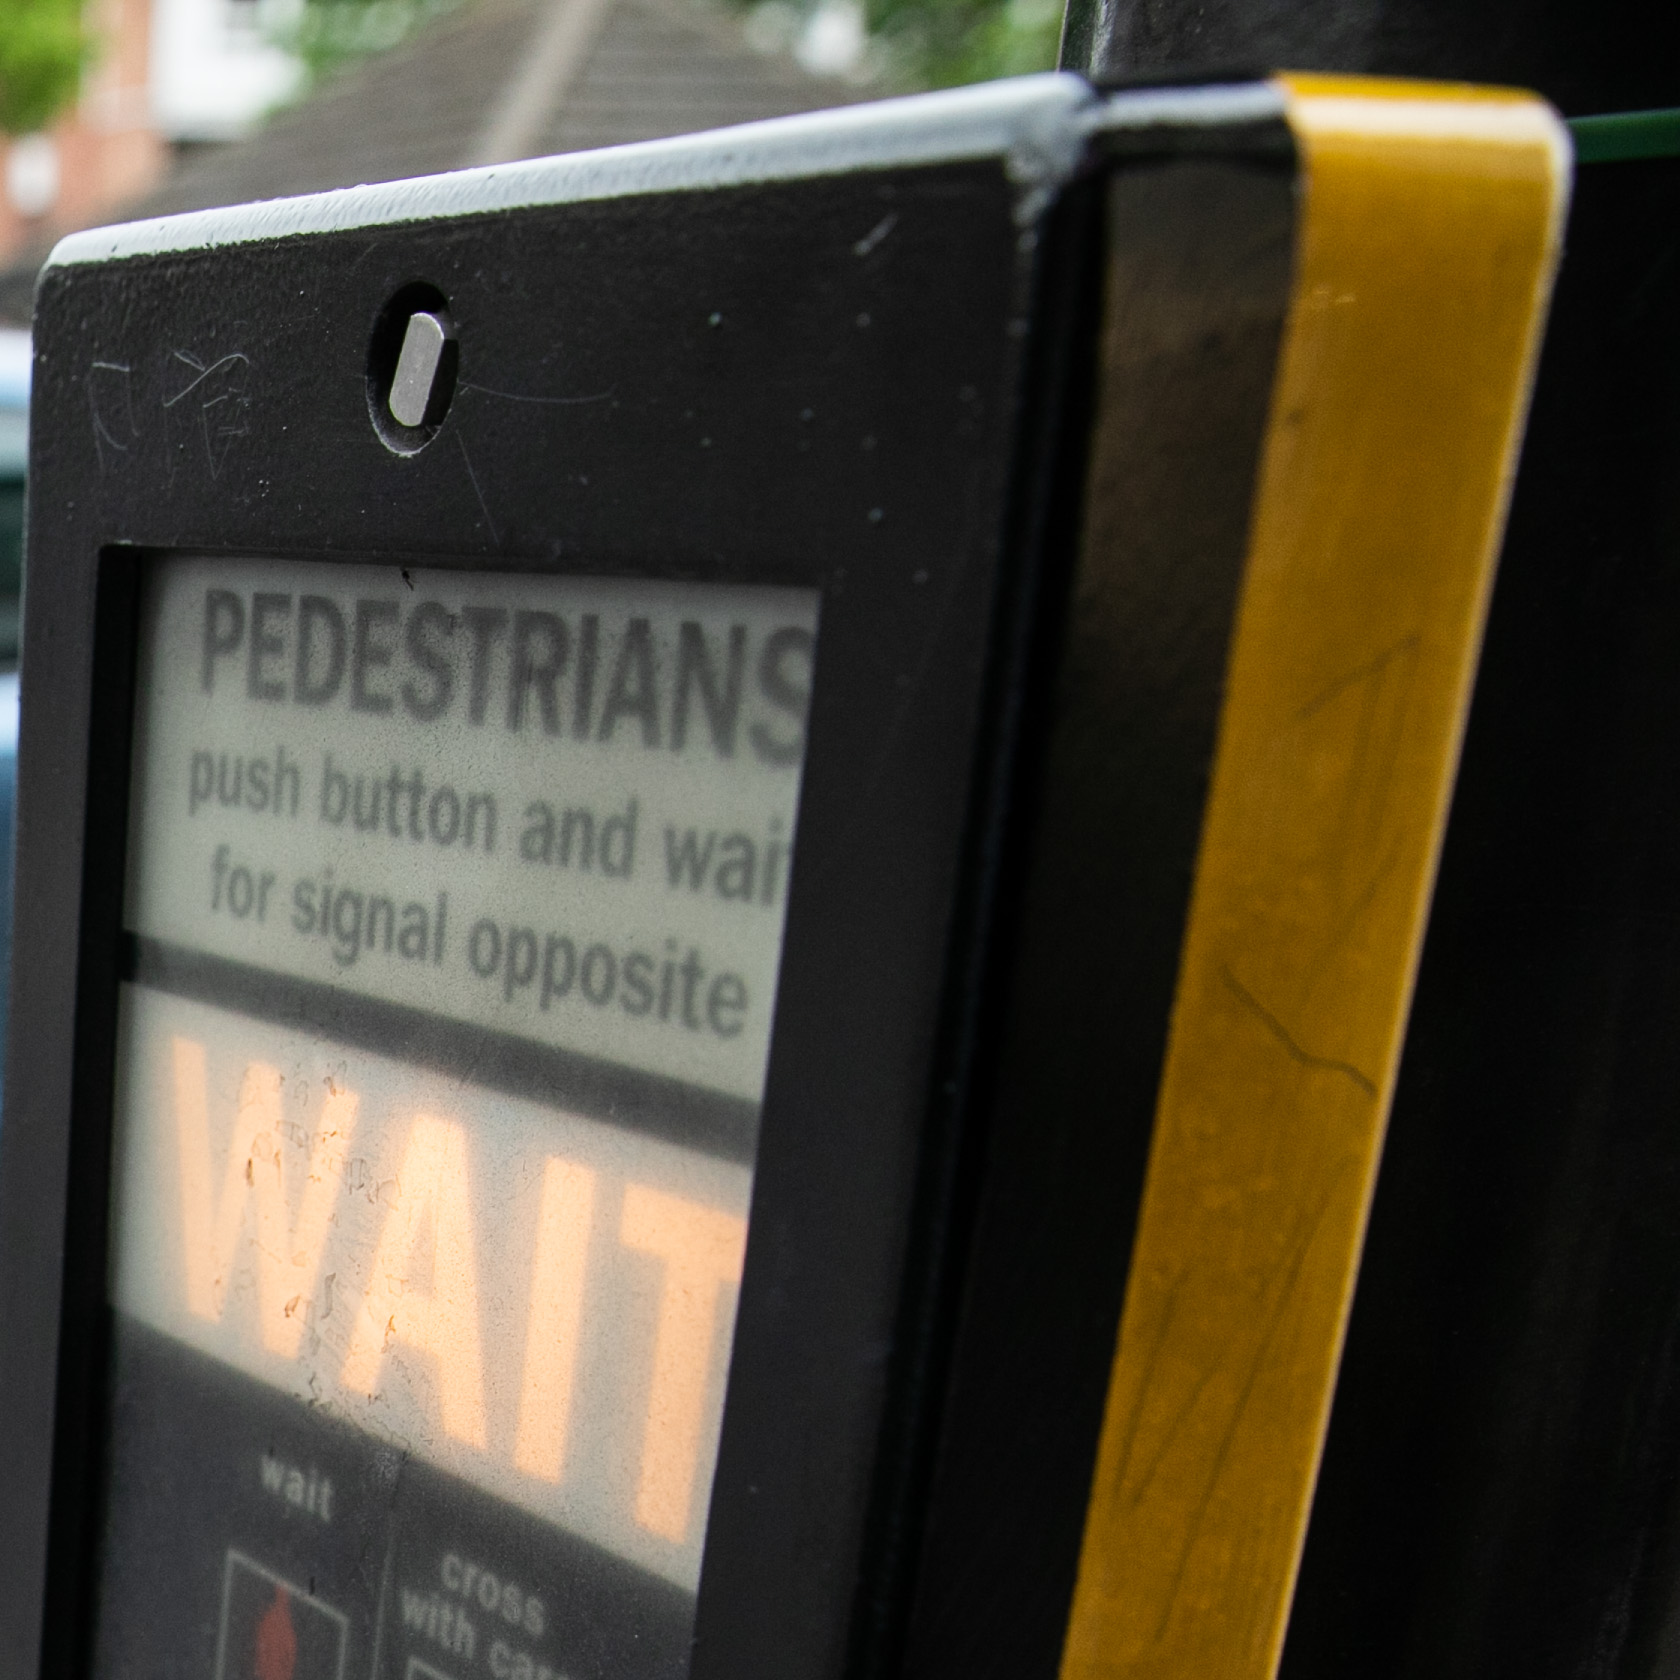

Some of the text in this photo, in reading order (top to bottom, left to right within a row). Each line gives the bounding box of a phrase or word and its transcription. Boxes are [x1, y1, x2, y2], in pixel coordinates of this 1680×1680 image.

[200, 589, 816, 767] PEDESTRIANS
[188, 746, 792, 908] push button and wai
[212, 845, 750, 1039] for signal opposite
[172, 1036, 748, 1545] WAIT
[261, 1453, 334, 1521] wait
[401, 1590, 476, 1660] with
[442, 1554, 546, 1637] cross
